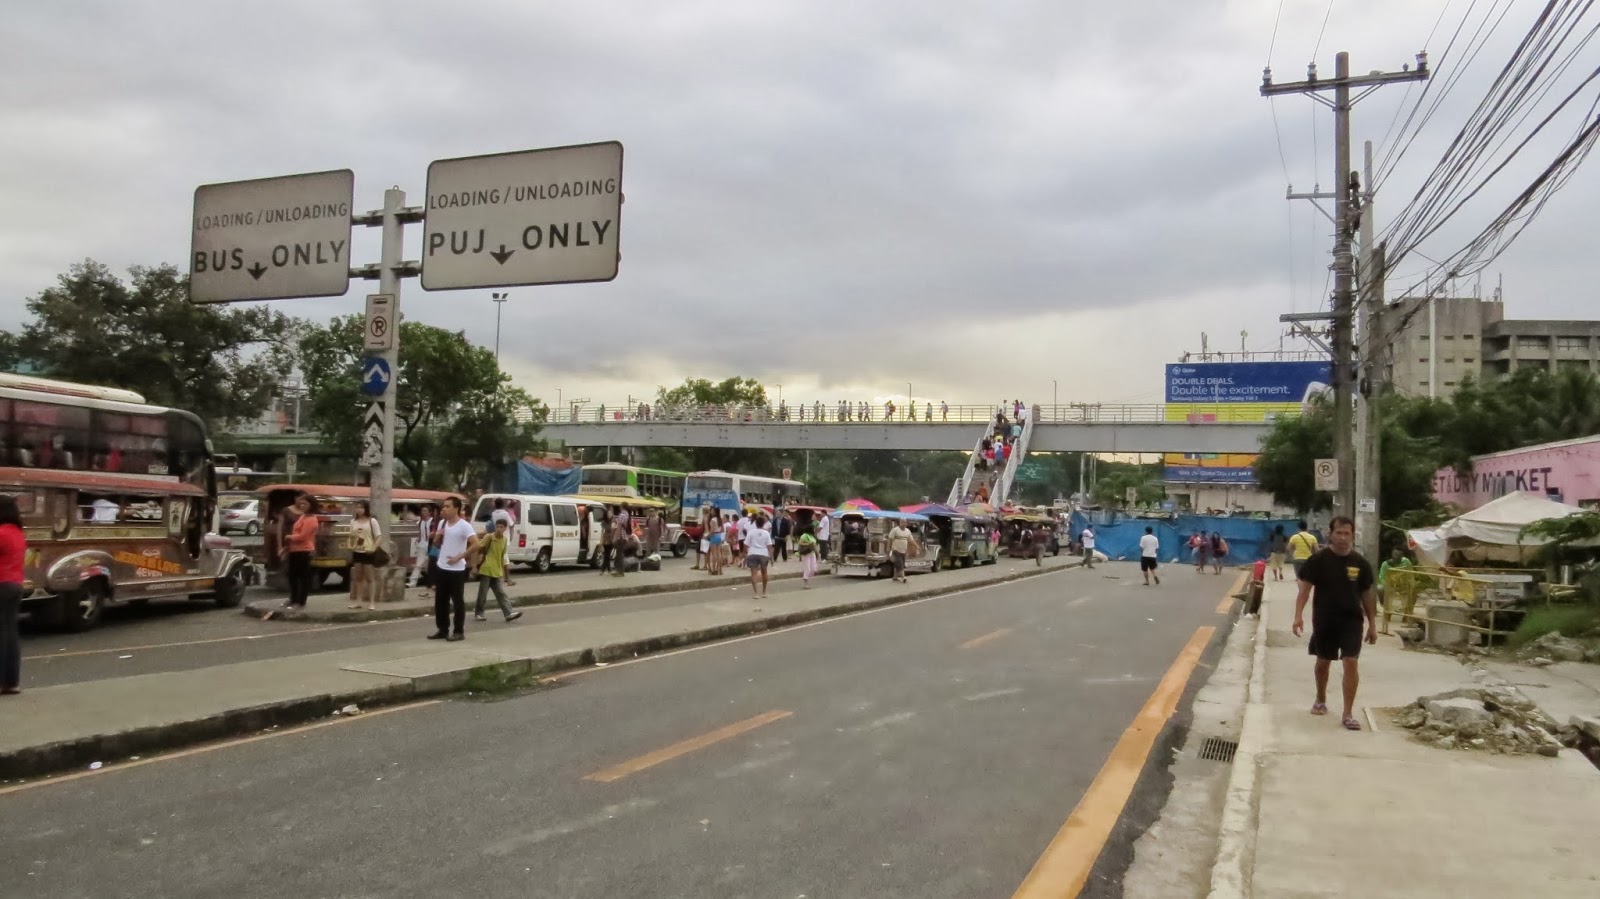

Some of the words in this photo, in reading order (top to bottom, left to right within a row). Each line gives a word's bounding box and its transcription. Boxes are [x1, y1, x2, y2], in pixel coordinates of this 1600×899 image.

[429, 185, 500, 210] LOADING
[515, 178, 616, 202] UNLOADING
[197, 211, 253, 231] LOADING
[265, 202, 348, 224] UNLOADING
[429, 229, 485, 257] PUJ
[522, 219, 612, 251] ONLY
[194, 247, 244, 274] BUS
[271, 239, 345, 268] ONLY
[1171, 385, 1208, 395] Double
[1210, 386, 1227, 394] the
[1229, 385, 1290, 395] excitement.
[1482, 467, 1552, 494] MKET
